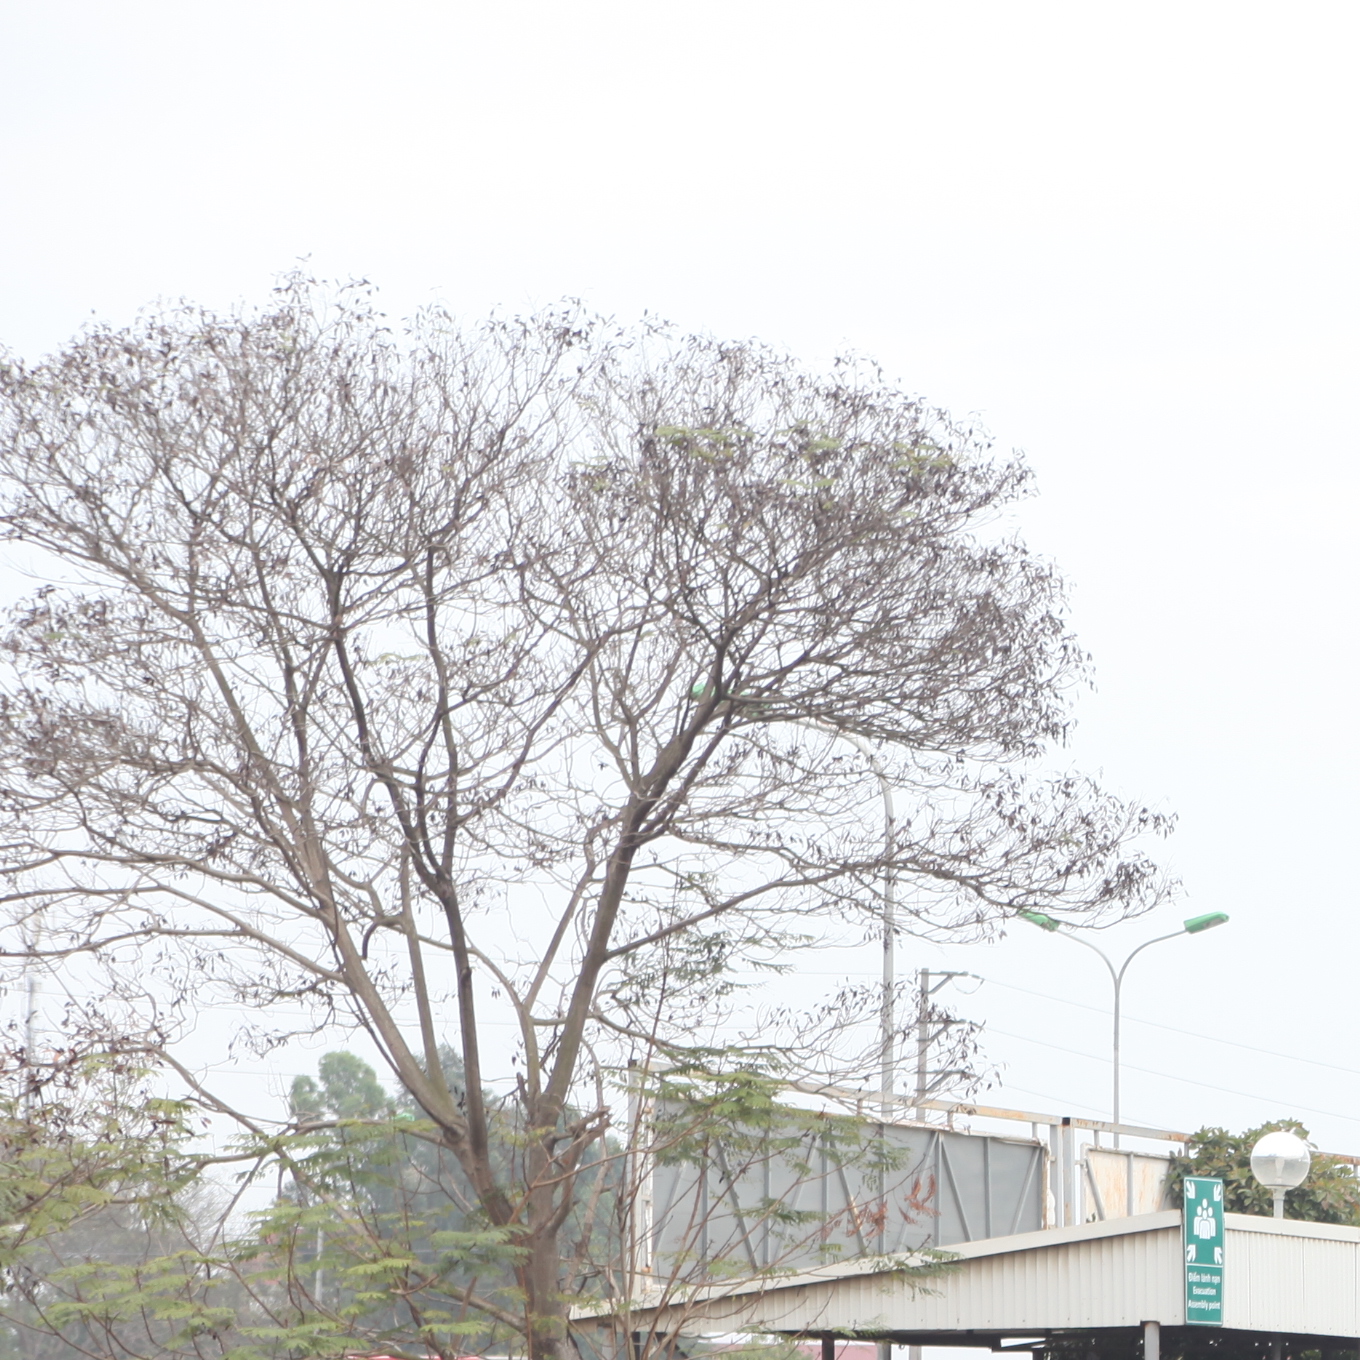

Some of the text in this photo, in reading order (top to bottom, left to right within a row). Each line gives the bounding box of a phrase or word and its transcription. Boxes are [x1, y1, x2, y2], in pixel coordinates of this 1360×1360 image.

[1192, 1286, 1217, 1295] Evacuation
[1188, 1300, 1220, 1311] Assembly point
